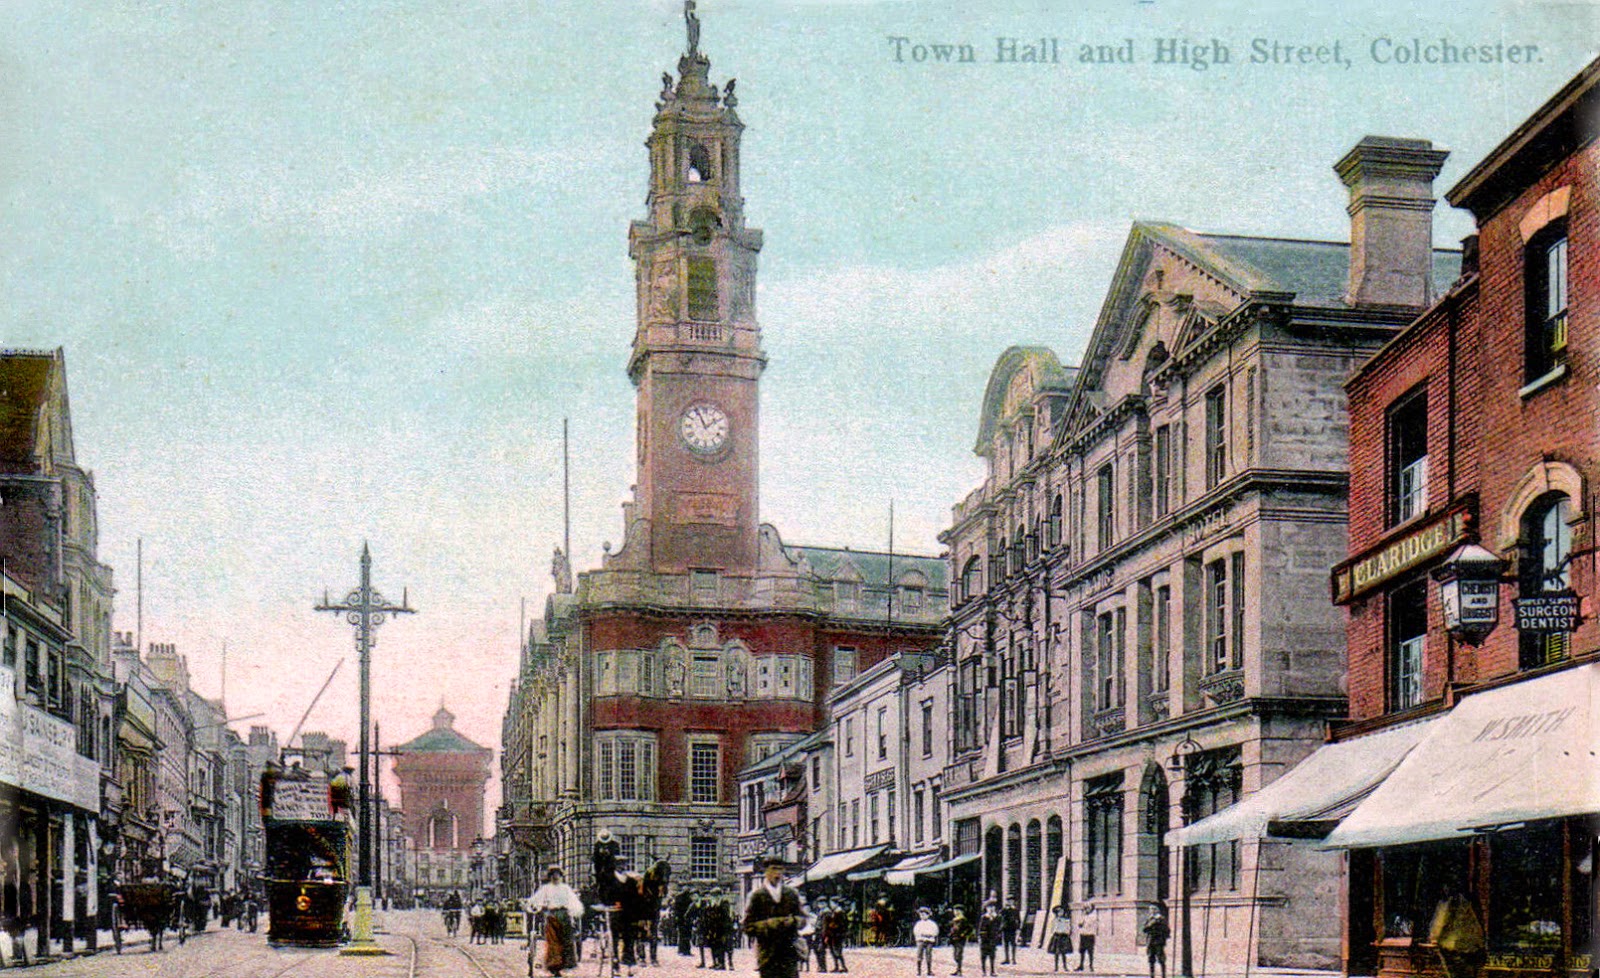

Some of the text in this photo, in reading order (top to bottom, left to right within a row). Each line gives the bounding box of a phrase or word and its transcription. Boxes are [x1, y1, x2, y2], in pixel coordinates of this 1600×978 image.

[1354, 526, 1445, 586] CLARIDGE
[1519, 604, 1577, 617] SURGEON
[1520, 617, 1575, 629] DENTIST
